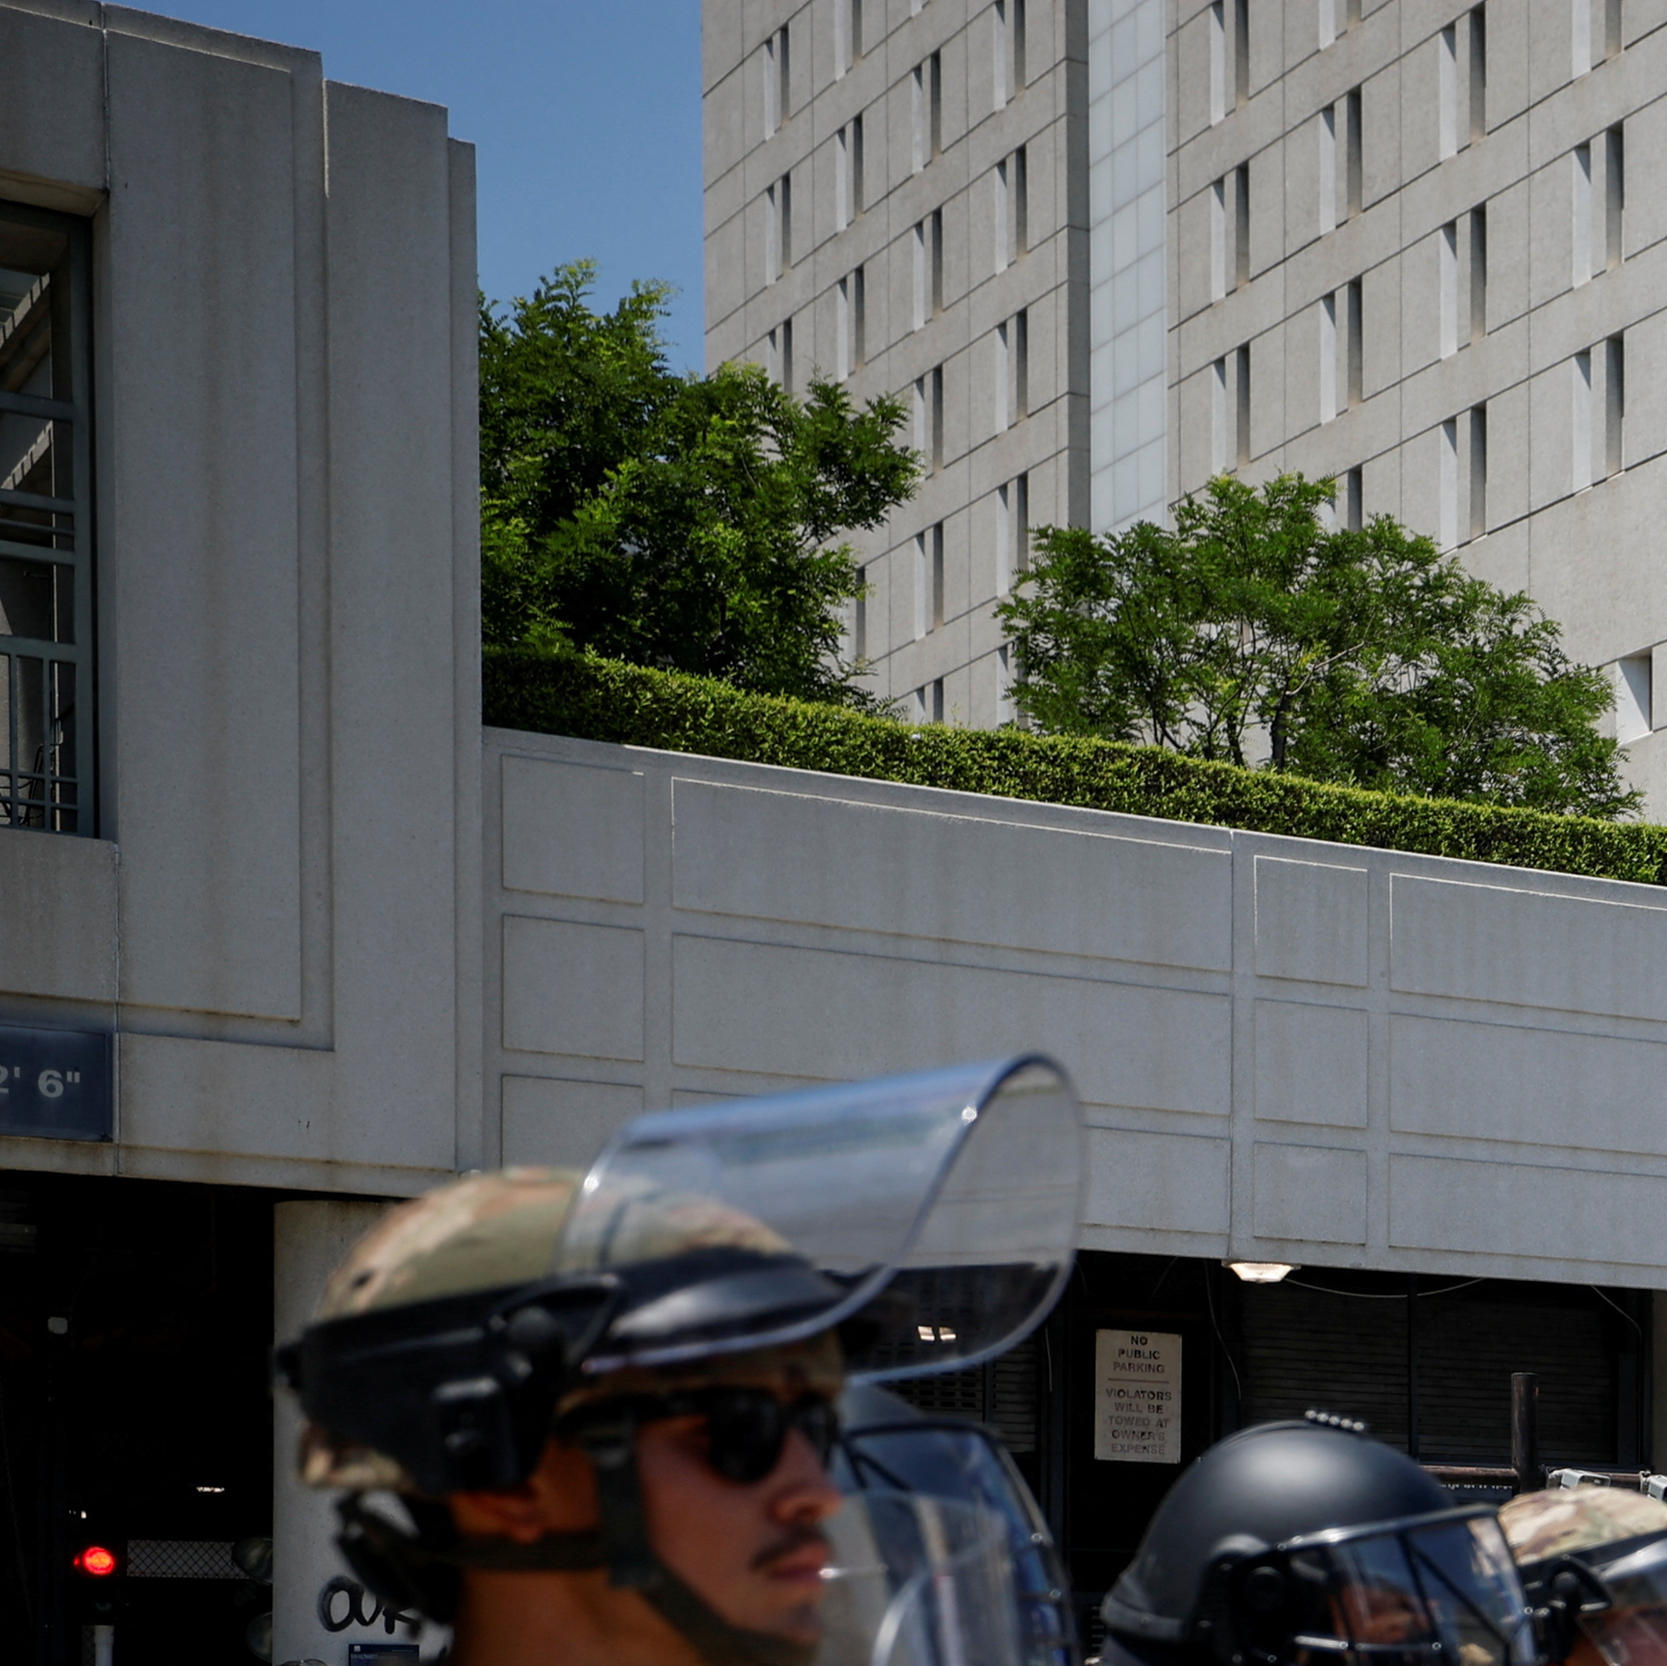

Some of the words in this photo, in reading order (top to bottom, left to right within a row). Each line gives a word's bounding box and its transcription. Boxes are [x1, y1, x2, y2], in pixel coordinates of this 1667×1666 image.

[38, 1069, 80, 1098] 6"
[1130, 1336, 1148, 1346] NO
[1118, 1349, 1161, 1360] PUBLIC
[1112, 1361, 1165, 1374] PARKING
[1105, 1388, 1172, 1401] VIOLATORS
[1114, 1402, 1143, 1413] WILL
[1148, 1404, 1164, 1414] BE
[1108, 1416, 1150, 1428] TOWED
[1155, 1417, 1170, 1428] AT
[1111, 1443, 1166, 1455] EXPENSE
